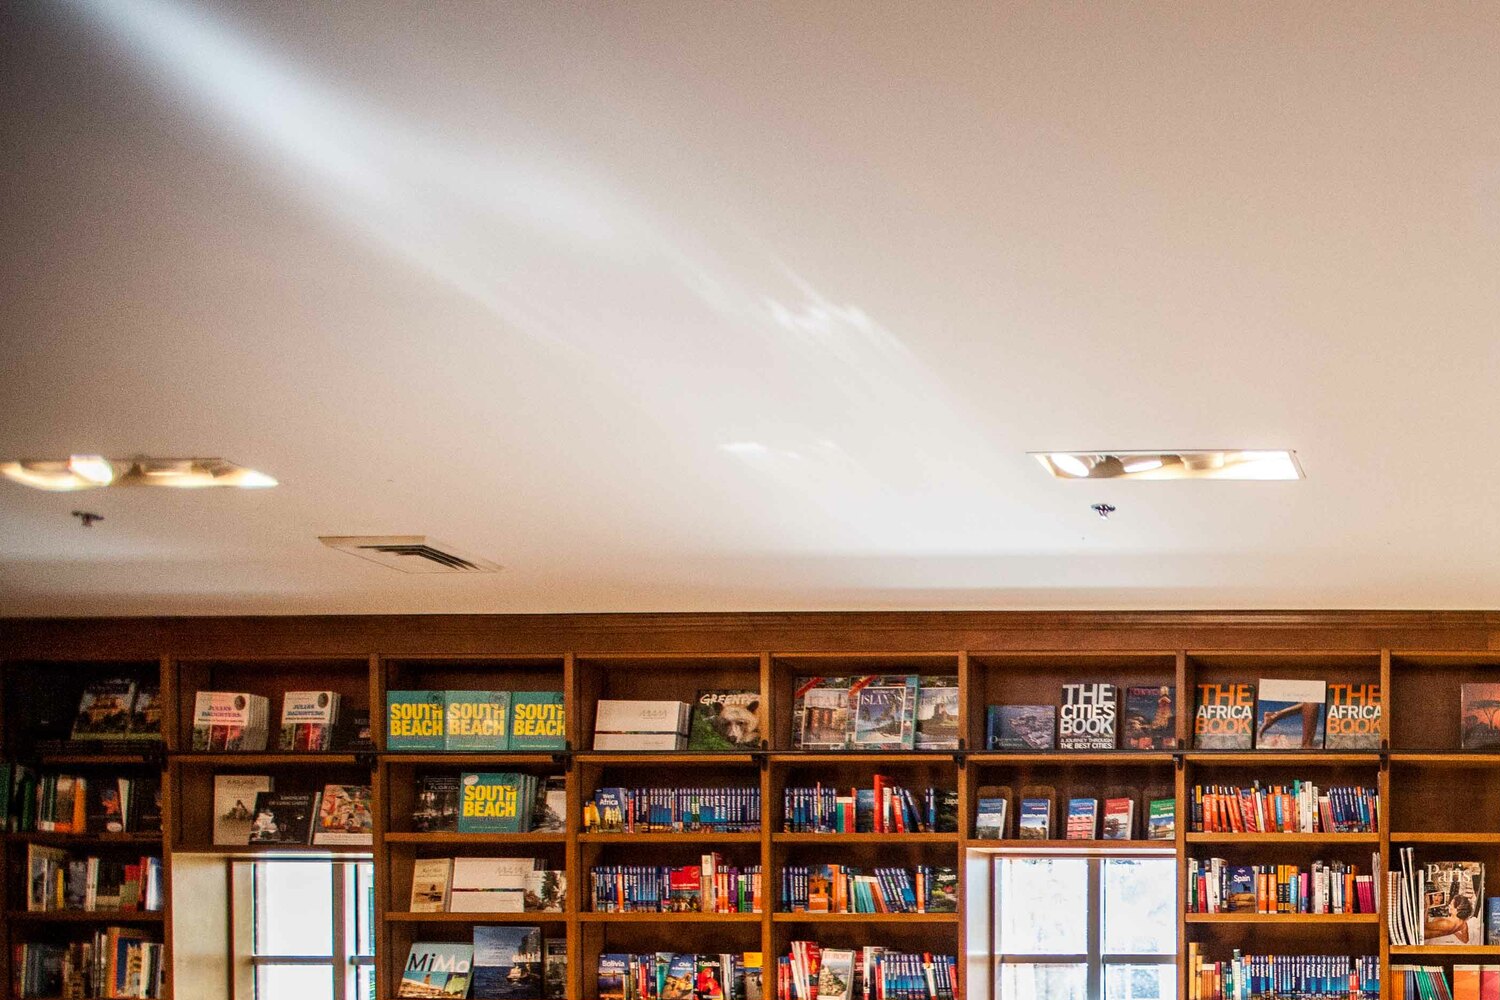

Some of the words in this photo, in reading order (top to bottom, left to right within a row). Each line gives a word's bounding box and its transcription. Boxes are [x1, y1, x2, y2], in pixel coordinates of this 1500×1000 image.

[1062, 683, 1114, 705] THE
[1197, 684, 1253, 706] THE
[1328, 684, 1381, 706] THE
[390, 703, 444, 720] SOUTH
[449, 703, 505, 720] SOUTH
[514, 703, 566, 720] SOUTH
[1060, 704, 1115, 719] CITIES
[1197, 705, 1253, 719] AFRICA
[1327, 705, 1381, 719] AFRICA
[390, 719, 444, 736] BEACH
[449, 719, 505, 736] BEACH
[513, 719, 566, 736] BEACH
[1060, 718, 1114, 734] BOOK
[1195, 718, 1252, 734] BOOK
[1326, 718, 1381, 734] BOOK
[464, 785, 517, 801] SOUTH
[462, 800, 517, 817] BEACH
[936, 873, 956, 882] Japan
[1233, 874, 1251, 883] Spain
[1427, 864, 1472, 883] Paris
[408, 953, 470, 972] MiMo
[602, 960, 625, 968] Bolivia
